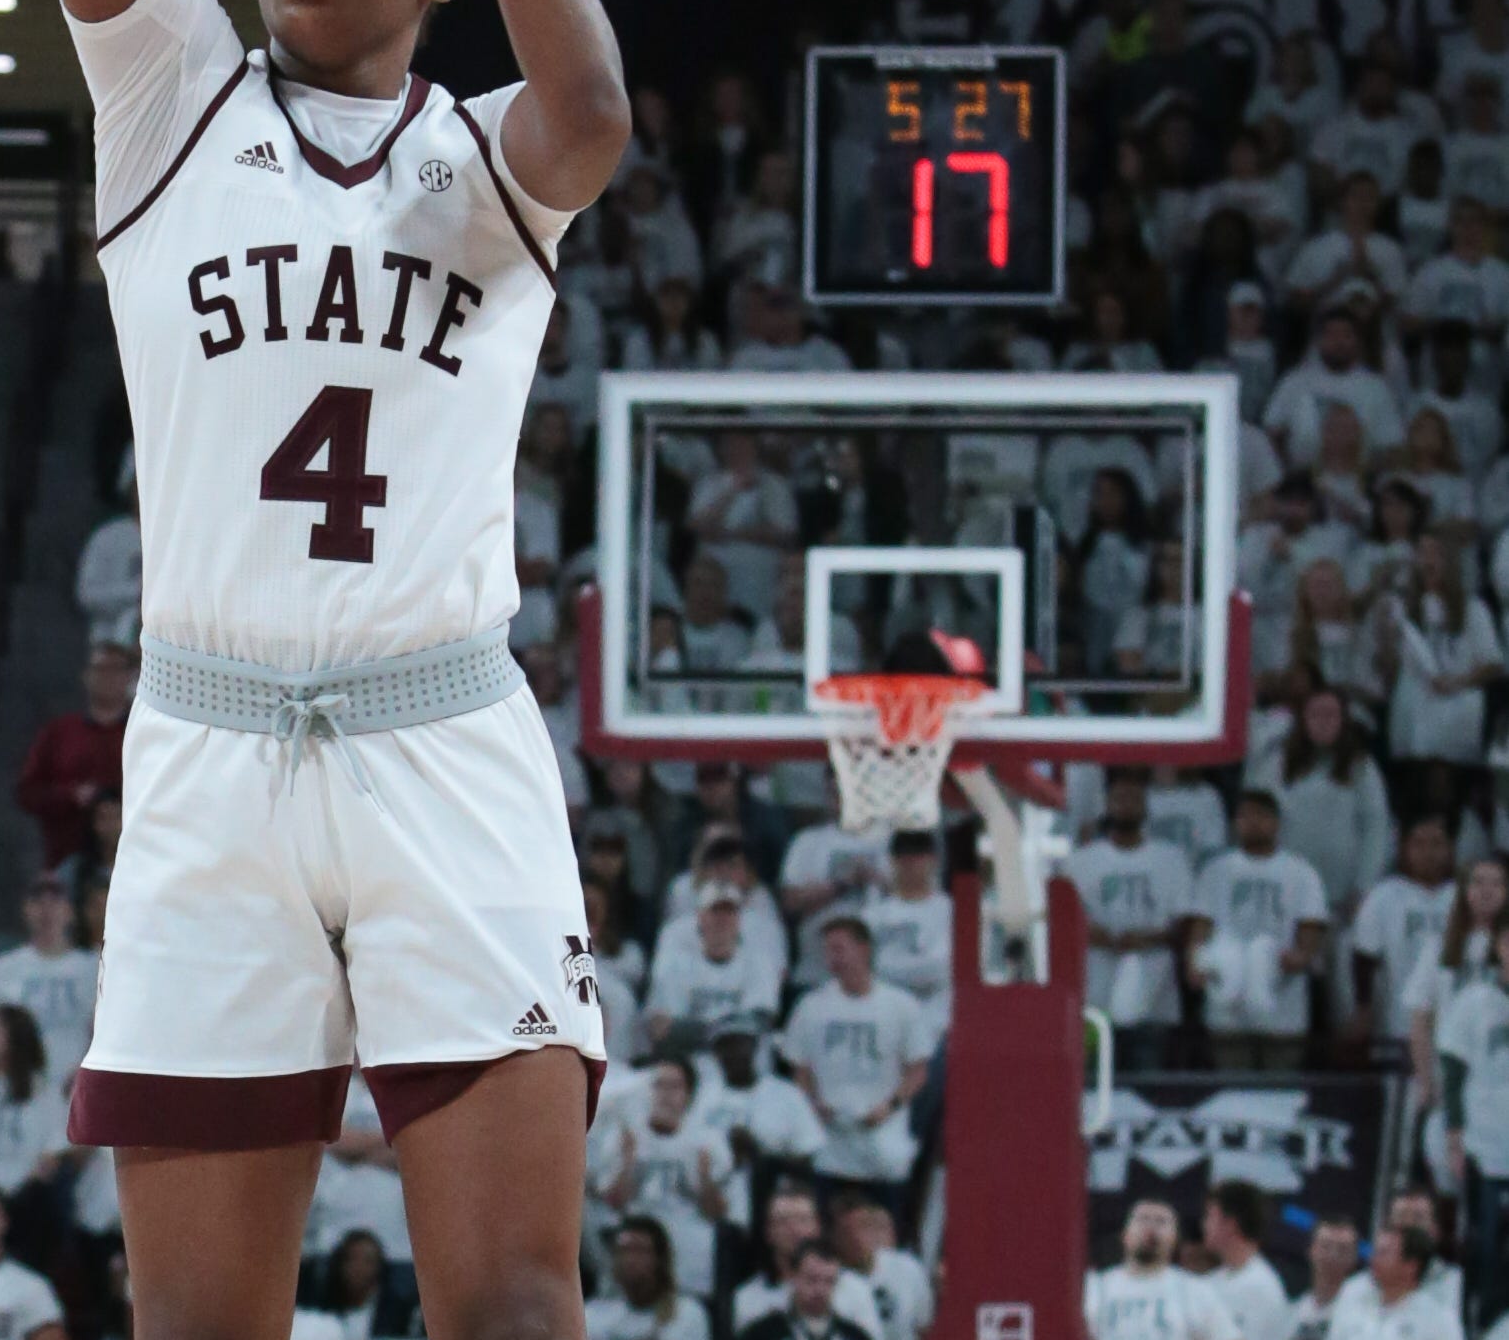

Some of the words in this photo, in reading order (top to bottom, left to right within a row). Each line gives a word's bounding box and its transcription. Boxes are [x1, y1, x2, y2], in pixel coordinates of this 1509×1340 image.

[234, 153, 285, 175] adidas
[420, 160, 453, 192] SEC
[912, 151, 1010, 269] 17
[187, 243, 484, 378] STATE
[259, 384, 388, 564] 4
[512, 1022, 558, 1036] adidas
